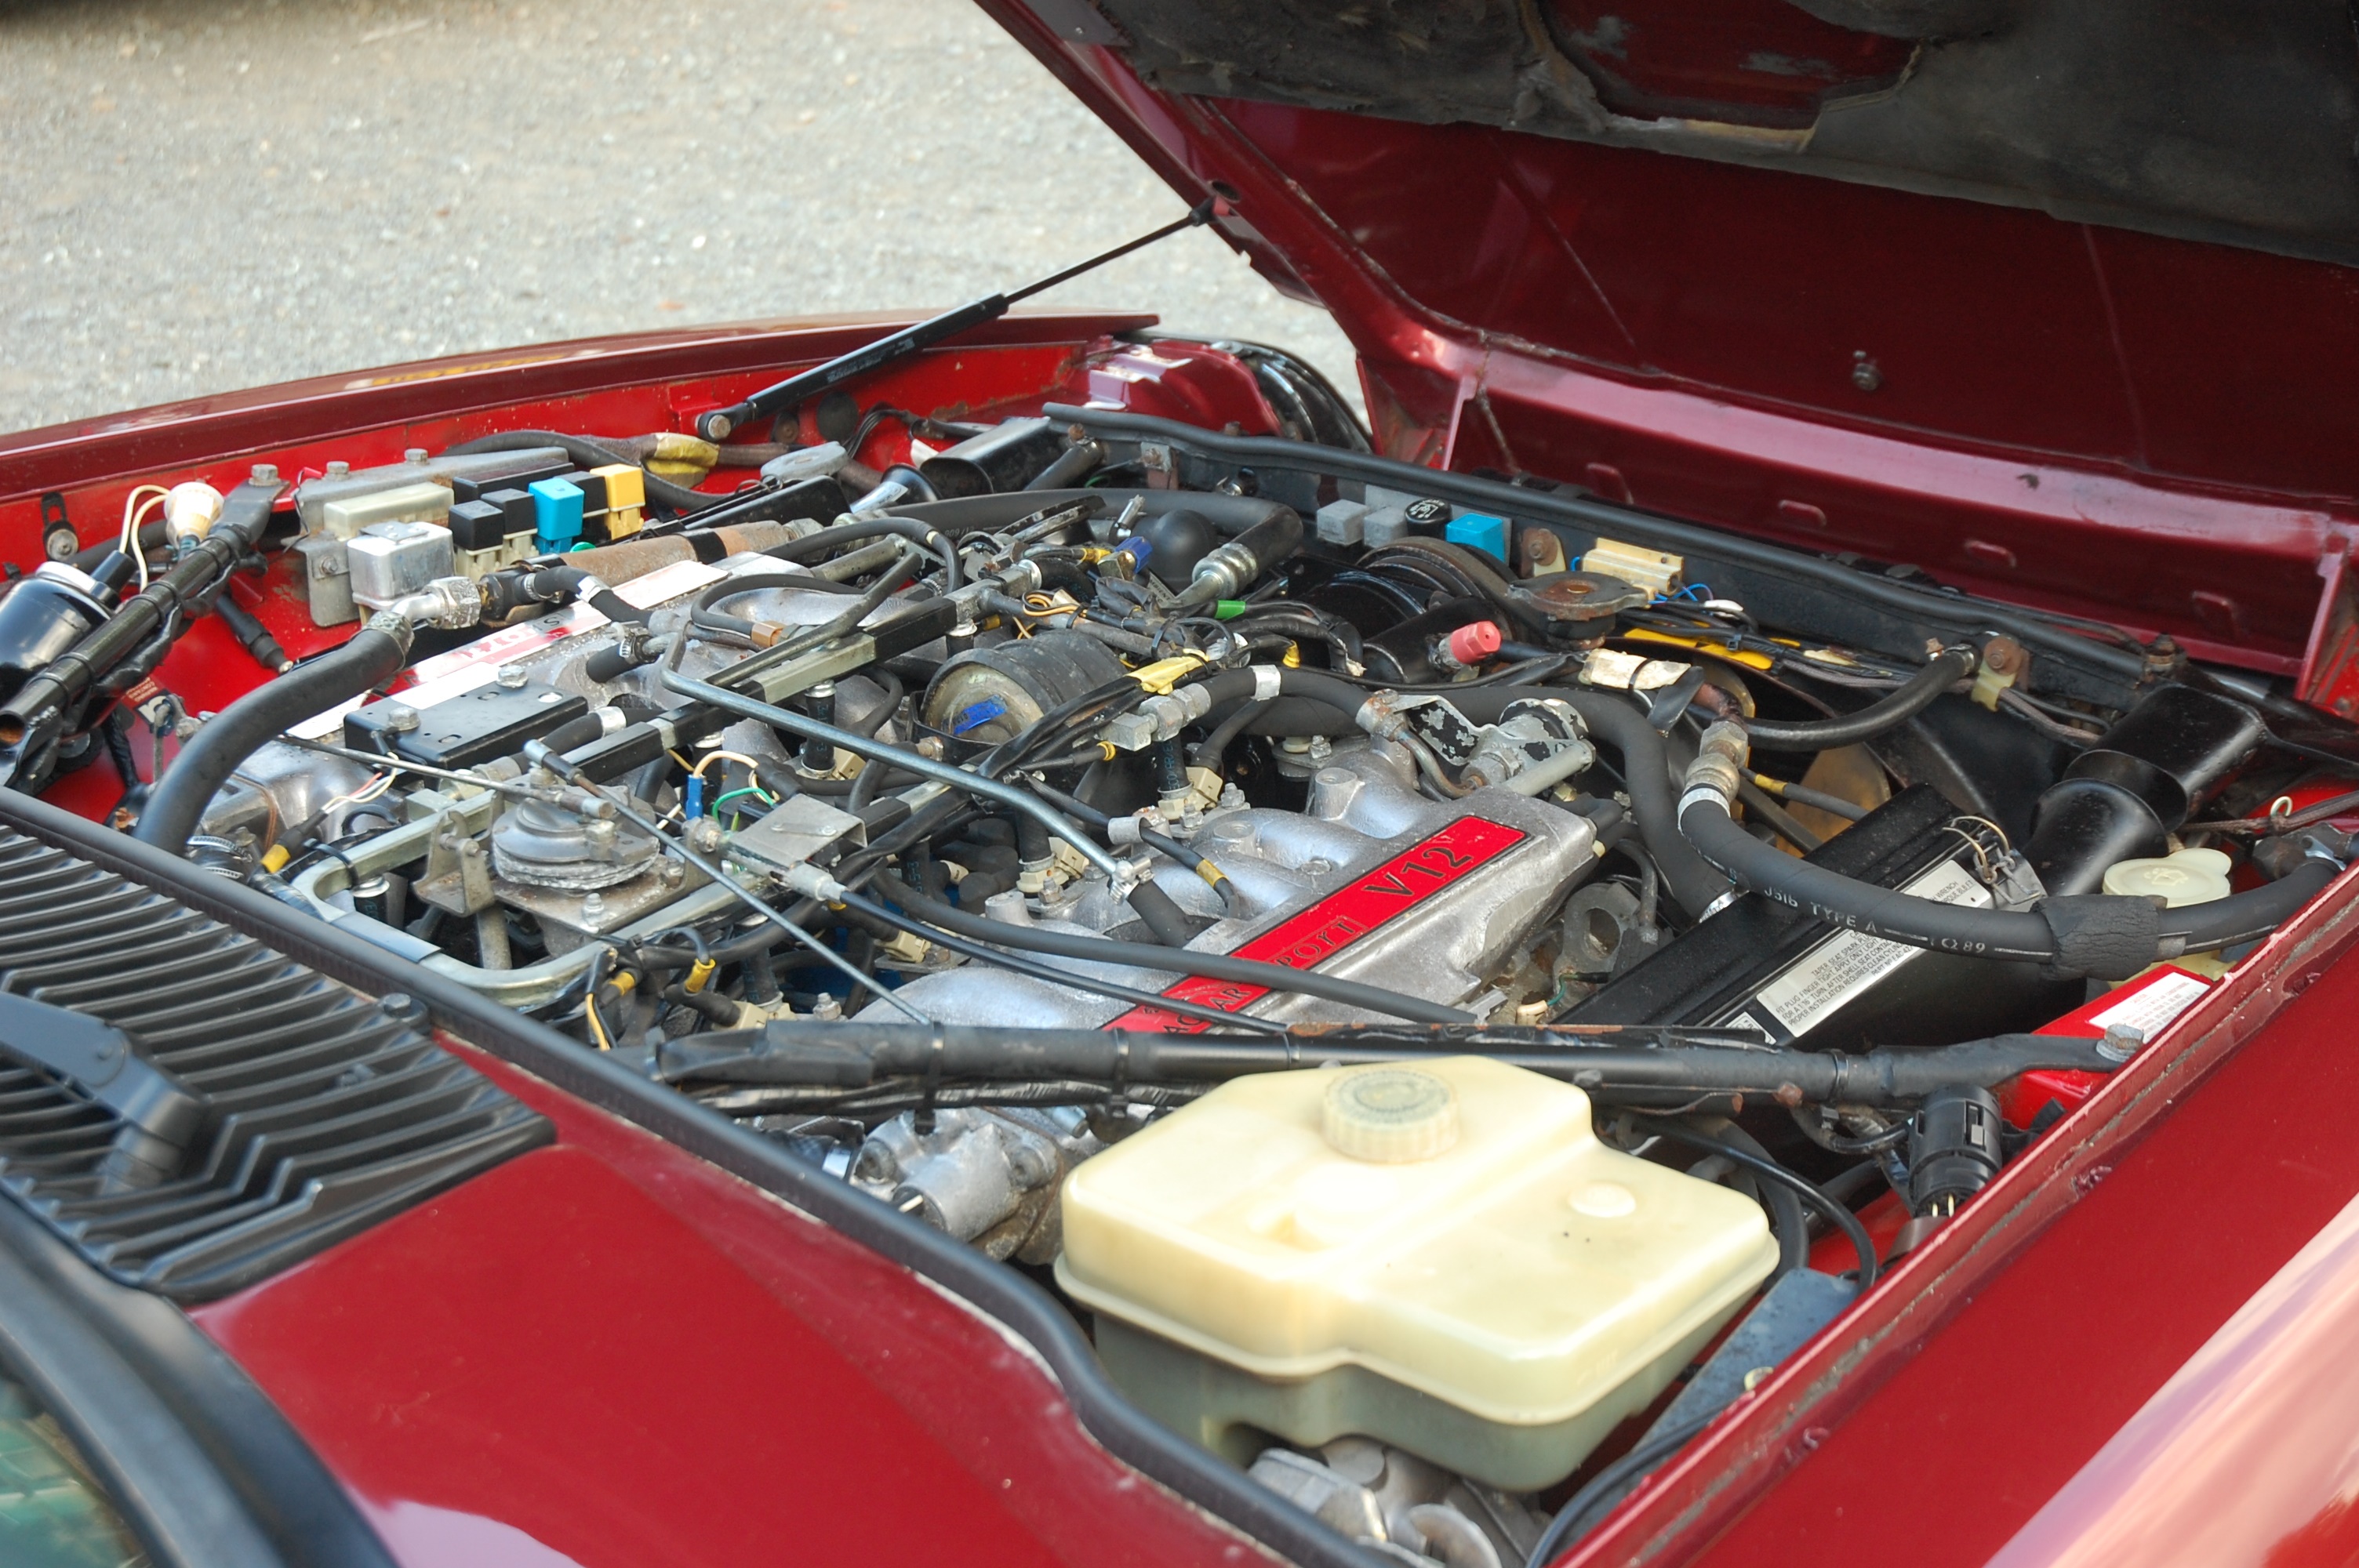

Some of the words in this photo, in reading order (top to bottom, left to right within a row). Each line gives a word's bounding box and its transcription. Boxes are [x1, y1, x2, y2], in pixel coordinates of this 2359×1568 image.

[1363, 846, 1475, 898] V12
[1810, 902, 1857, 928] TYPE
[1865, 920, 1878, 934] A
[1774, 1005, 1786, 1014] FIT
[1783, 994, 1801, 1008] PLUG
[1797, 980, 1820, 997] FINGER
[1833, 957, 1852, 972] APPLY
[1848, 947, 1866, 961] ONLY
[1861, 938, 1880, 952] LIGHT
[1781, 1009, 1794, 1020] FOR
[1825, 973, 1845, 989] AFTER
[1841, 962, 1859, 976] SHELL
[1856, 953, 1872, 965] SEAT
[1869, 938, 1892, 956] CONTAC
[1810, 961, 1830, 977] TAPER
[1826, 953, 1843, 965] SEAT
[1840, 941, 1859, 956] SPARK
[1856, 931, 1872, 944] PLU
[1870, 964, 1886, 976] PART
[1787, 1008, 1810, 1026] PROPER
[1807, 982, 1845, 1012] INSTALLATION
[1842, 965, 1870, 986] REQUIRES
[1866, 953, 1886, 969] CLEAN
